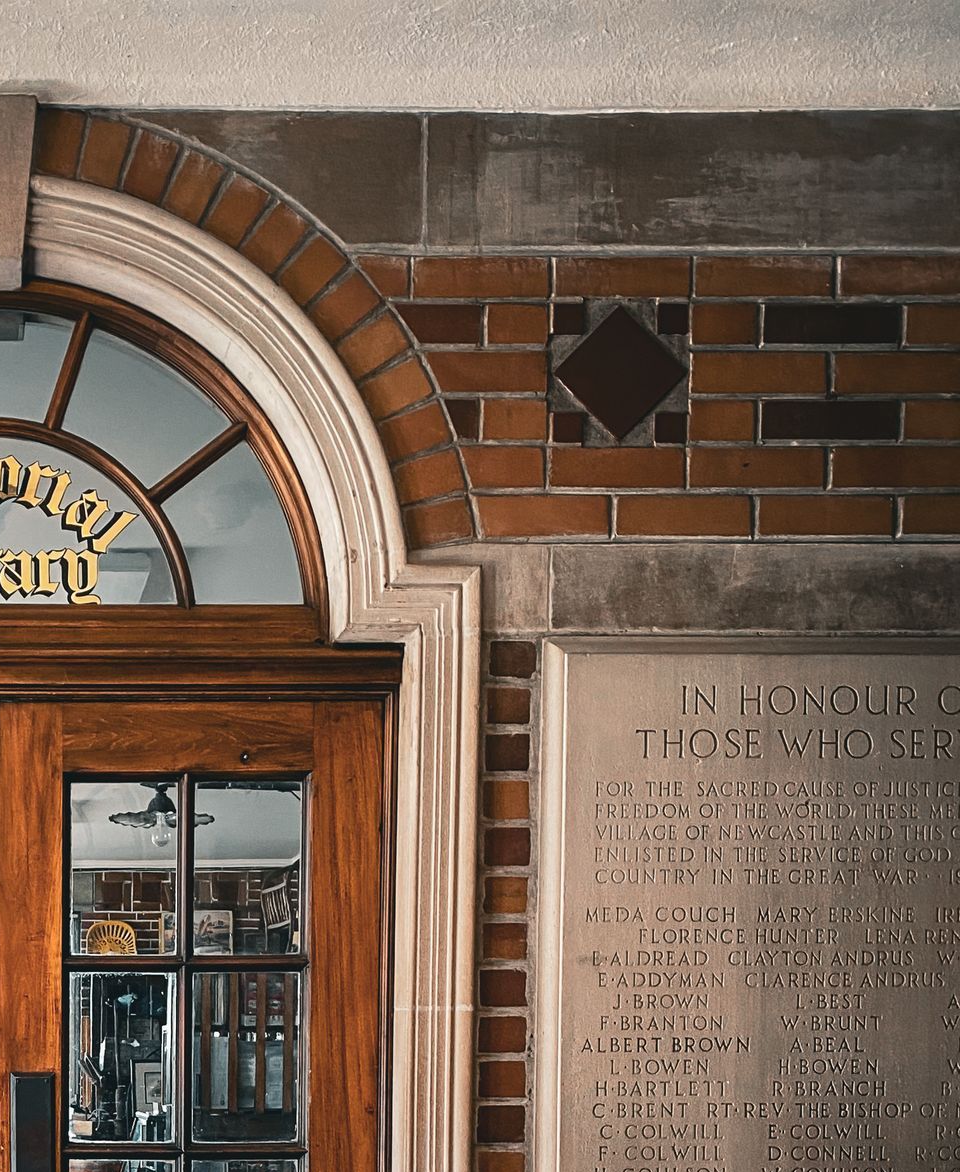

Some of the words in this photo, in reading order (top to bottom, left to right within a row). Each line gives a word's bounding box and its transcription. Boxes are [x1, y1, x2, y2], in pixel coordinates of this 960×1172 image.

[681, 685, 717, 715] IN
[740, 685, 916, 716] HONOUR
[636, 729, 762, 759] THOSE
[778, 729, 874, 759] WHO
[890, 729, 960, 759] SER
[596, 781, 634, 797] FOR
[646, 781, 684, 797] THE
[697, 781, 778, 797] SACRED
[784, 781, 845, 797] CAUSE
[853, 781, 878, 797] OF
[884, 781, 960, 797] JUSTIC
[595, 803, 690, 819] FREEDOM
[700, 803, 724, 819] OF
[732, 803, 768, 819] THE
[861, 803, 919, 819] THESE
[929, 803, 960, 819] ME
[596, 825, 677, 840] VILLAGE
[686, 825, 711, 840] OF
[719, 825, 841, 840] NEWCASTLE
[849, 825, 894, 841] AND
[901, 825, 944, 841] THIS
[595, 847, 695, 862] ENLISTED
[704, 847, 723, 862] IN
[734, 847, 768, 862] THE
[779, 848, 862, 863] SERVICE
[871, 848, 896, 863] OF
[904, 848, 951, 863] GOD
[595, 869, 700, 884] COUNTRY
[713, 869, 733, 884] IN
[744, 869, 781, 884] THE
[789, 869, 860, 885] GREAT
[873, 869, 918, 885] WAR
[586, 907, 644, 922] MEDA
[656, 907, 736, 922] COUCH
[758, 907, 817, 922] MARY
[829, 907, 916, 922] ERSKINE
[936, 907, 960, 923] IR
[640, 929, 745, 944] FLORENCE
[756, 929, 840, 944] HUNTER
[866, 929, 916, 944] LENA
[728, 951, 822, 966] CLAYTON
[831, 951, 914, 966] ANDRUS
[745, 972, 853, 988] CLARENCE
[860, 972, 945, 988] ANDRUS
[581, 1038, 662, 1053] ALBERT
[672, 1037, 751, 1053] BROWN
[795, 1103, 831, 1118] THE
[839, 1103, 912, 1118] BISHOP
